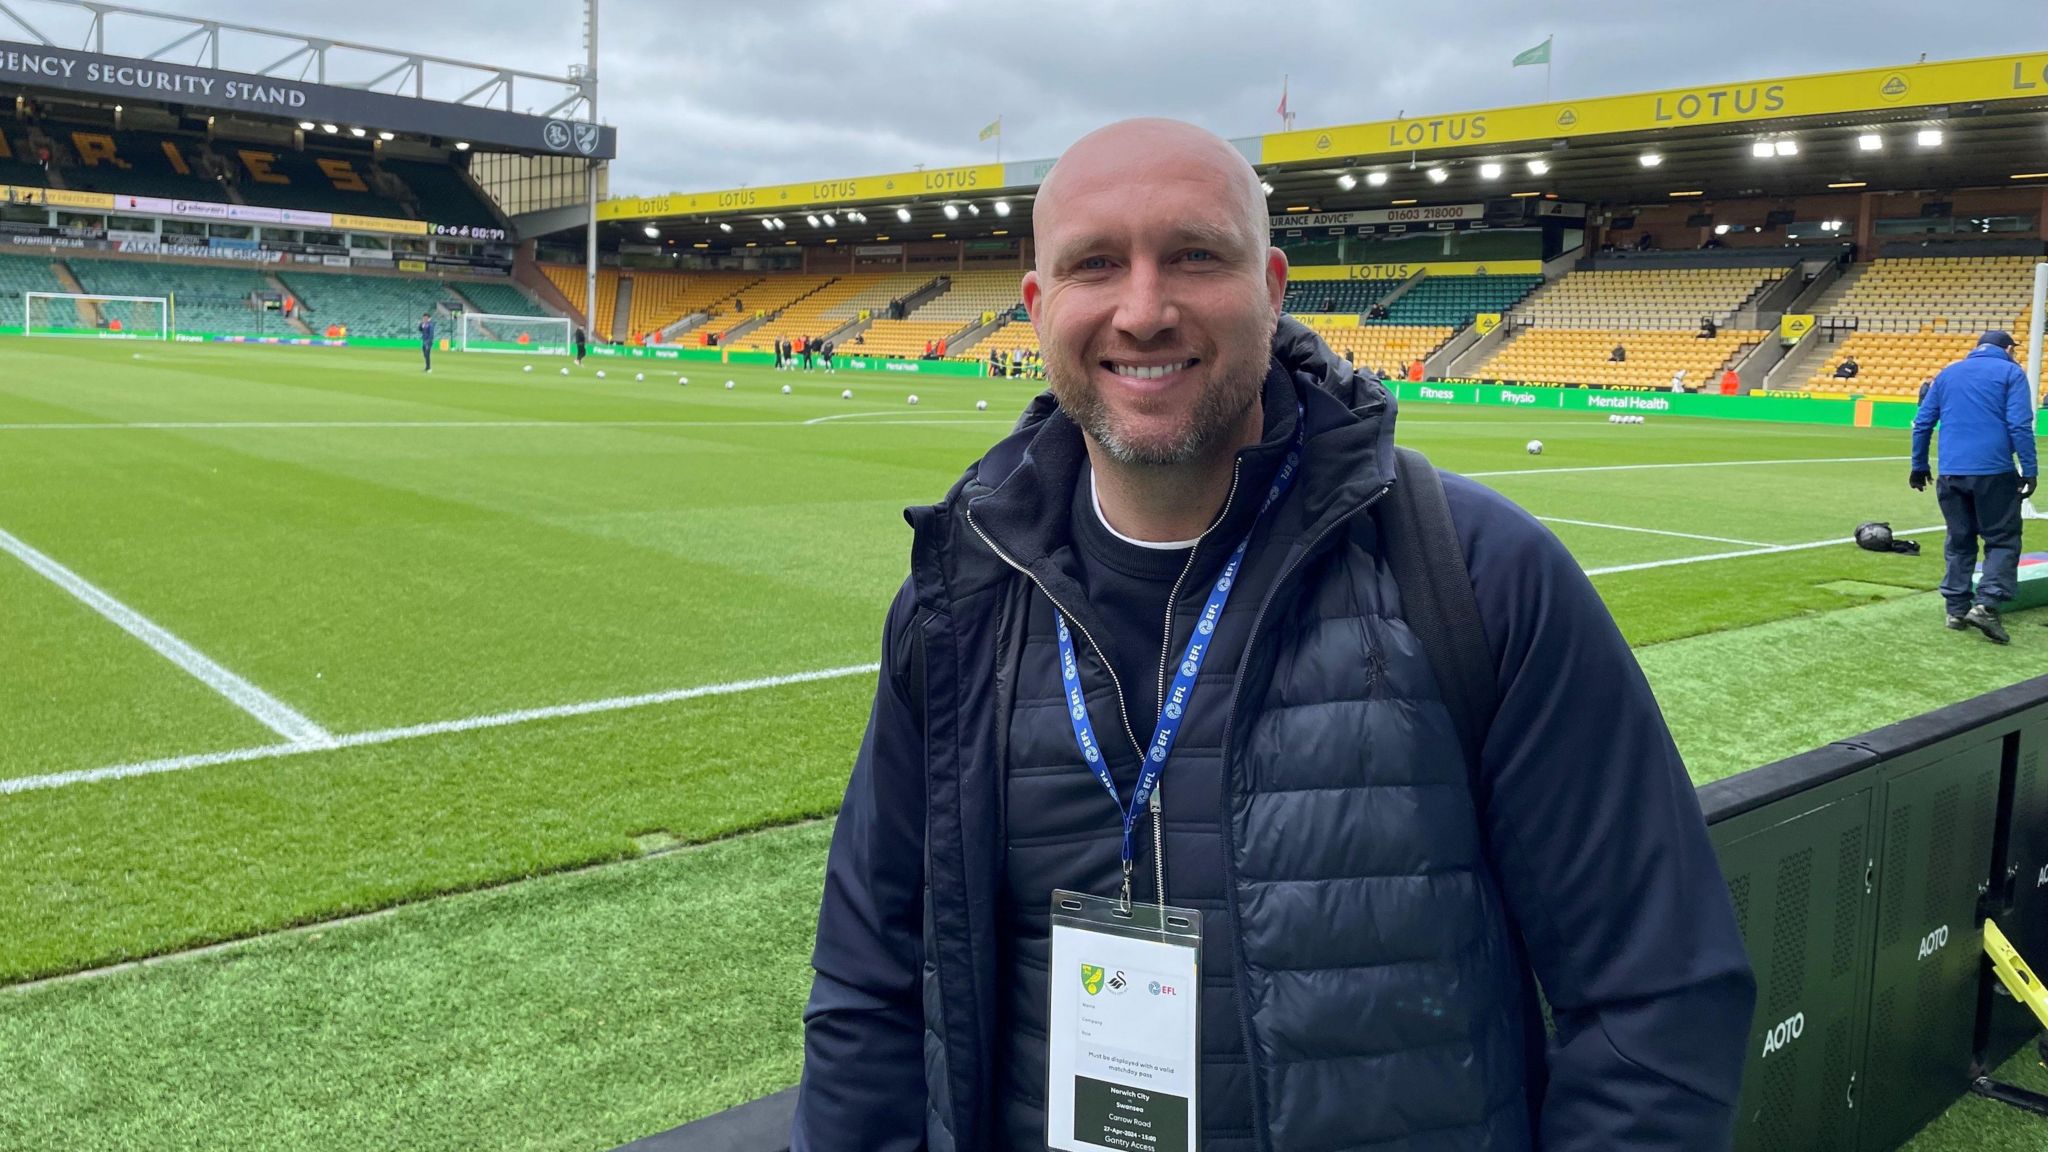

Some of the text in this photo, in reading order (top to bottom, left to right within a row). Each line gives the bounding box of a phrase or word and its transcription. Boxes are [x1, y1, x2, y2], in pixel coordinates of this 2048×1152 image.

[87, 63, 215, 96] SECURITY
[225, 80, 306, 107] STAND
[1655, 85, 1784, 122] LOTUS
[1390, 115, 1487, 147] LOTUS
[926, 170, 976, 190] LOTUS
[813, 182, 856, 199] LOTUS
[637, 200, 670, 214] LOTUS
[719, 192, 755, 207] LOTUS
[1271, 215, 1309, 227] URANCE
[1388, 211, 1420, 221] 01603
[1424, 207, 1463, 219] 218000
[125, 240, 278, 262] ALAN BOSWELL GROUP
[1350, 265, 1408, 278] LOTUS
[1420, 387, 1454, 399] Fitness
[1501, 390, 1536, 404] Physio
[1588, 395, 1669, 410] Mental Health
[1225, 561, 1237, 577] EFL
[1206, 603, 1219, 620] EFL
[1064, 648, 1073, 666] EFL
[1189, 644, 1202, 662] EFL
[1070, 686, 1080, 706] EFL
[1173, 686, 1186, 703] EFL
[1080, 728, 1091, 748] EFL
[1157, 728, 1170, 747] EFL
[1100, 770, 1111, 788] EFL
[1142, 772, 1155, 790] EFL
[1918, 925, 1948, 960] AOTO
[1162, 986, 1177, 996] EFL
[1762, 1012, 1804, 1058] AOTO
[1088, 1051, 1102, 1059] Must
[1111, 1057, 1139, 1067] displayed
[1140, 1062, 1153, 1070] with
[1159, 1066, 1175, 1074] valid
[1109, 1065, 1153, 1079] matchday pass
[1110, 1087, 1136, 1098] Norwich
[1136, 1092, 1150, 1102] City
[1116, 1101, 1144, 1113] Swansea
[1108, 1113, 1152, 1128] Carrow Road
[1104, 1135, 1155, 1152] Gantry Access
